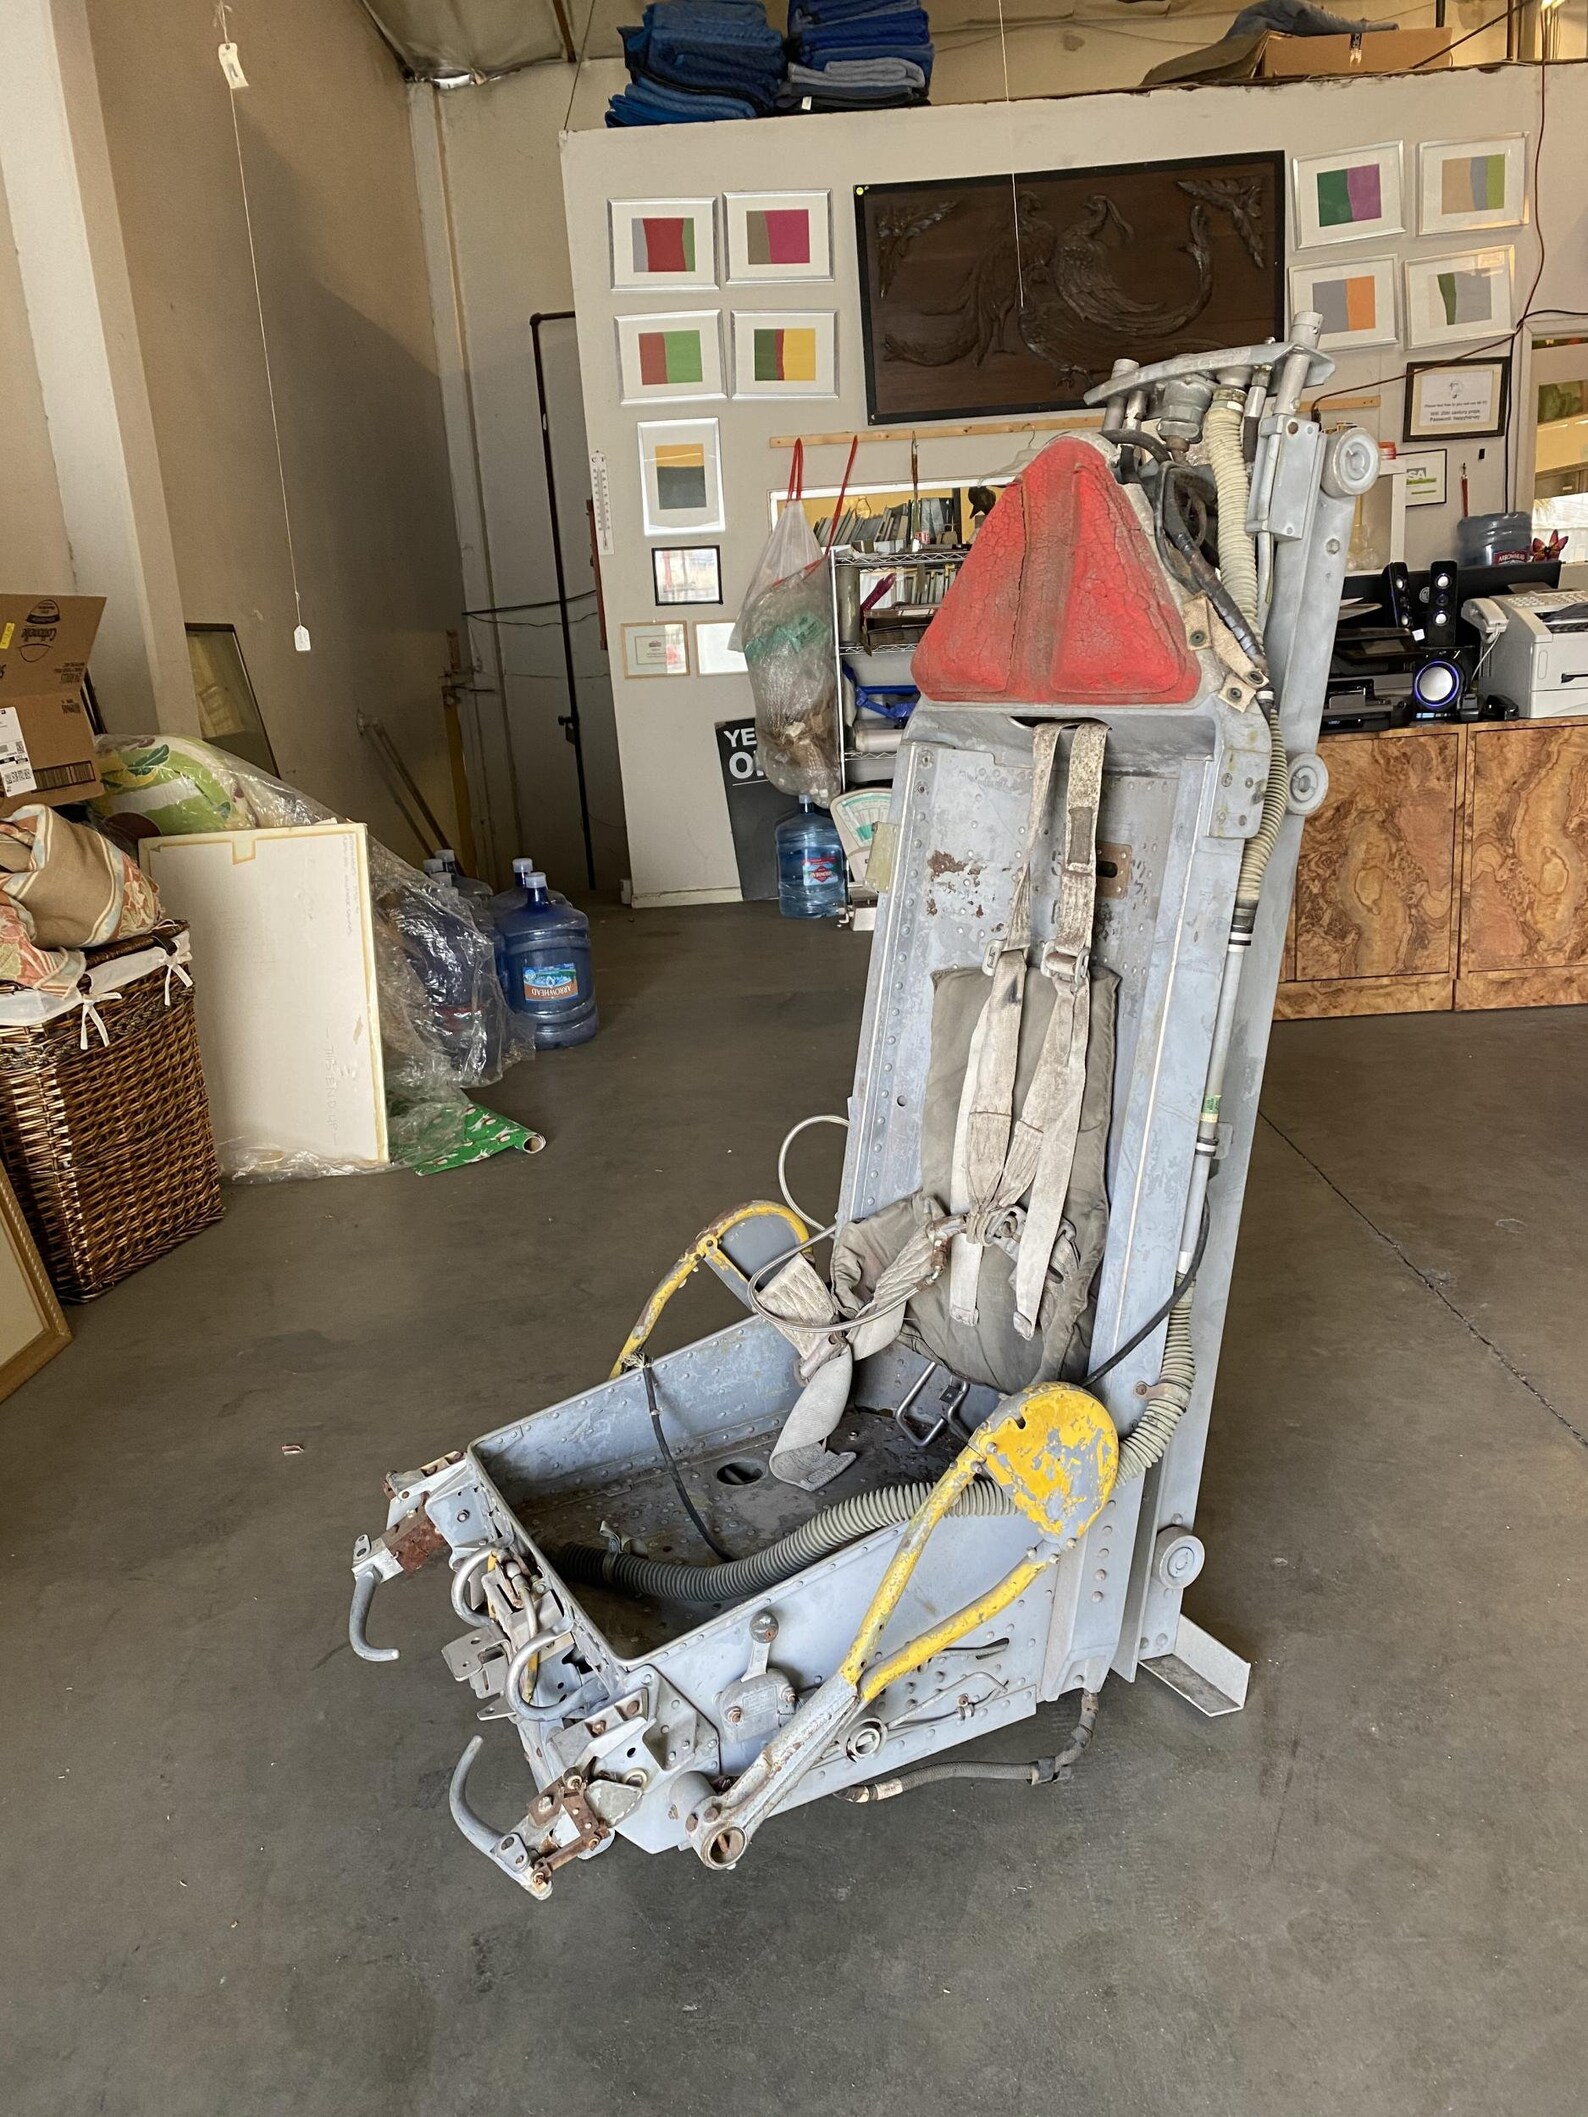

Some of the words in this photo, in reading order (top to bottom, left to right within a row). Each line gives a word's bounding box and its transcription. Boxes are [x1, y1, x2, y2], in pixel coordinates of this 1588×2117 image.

[723, 727, 757, 747] YE
[729, 751, 764, 779] O
[531, 985, 572, 997] ARROWHEAD
[325, 1076, 337, 1108] END
